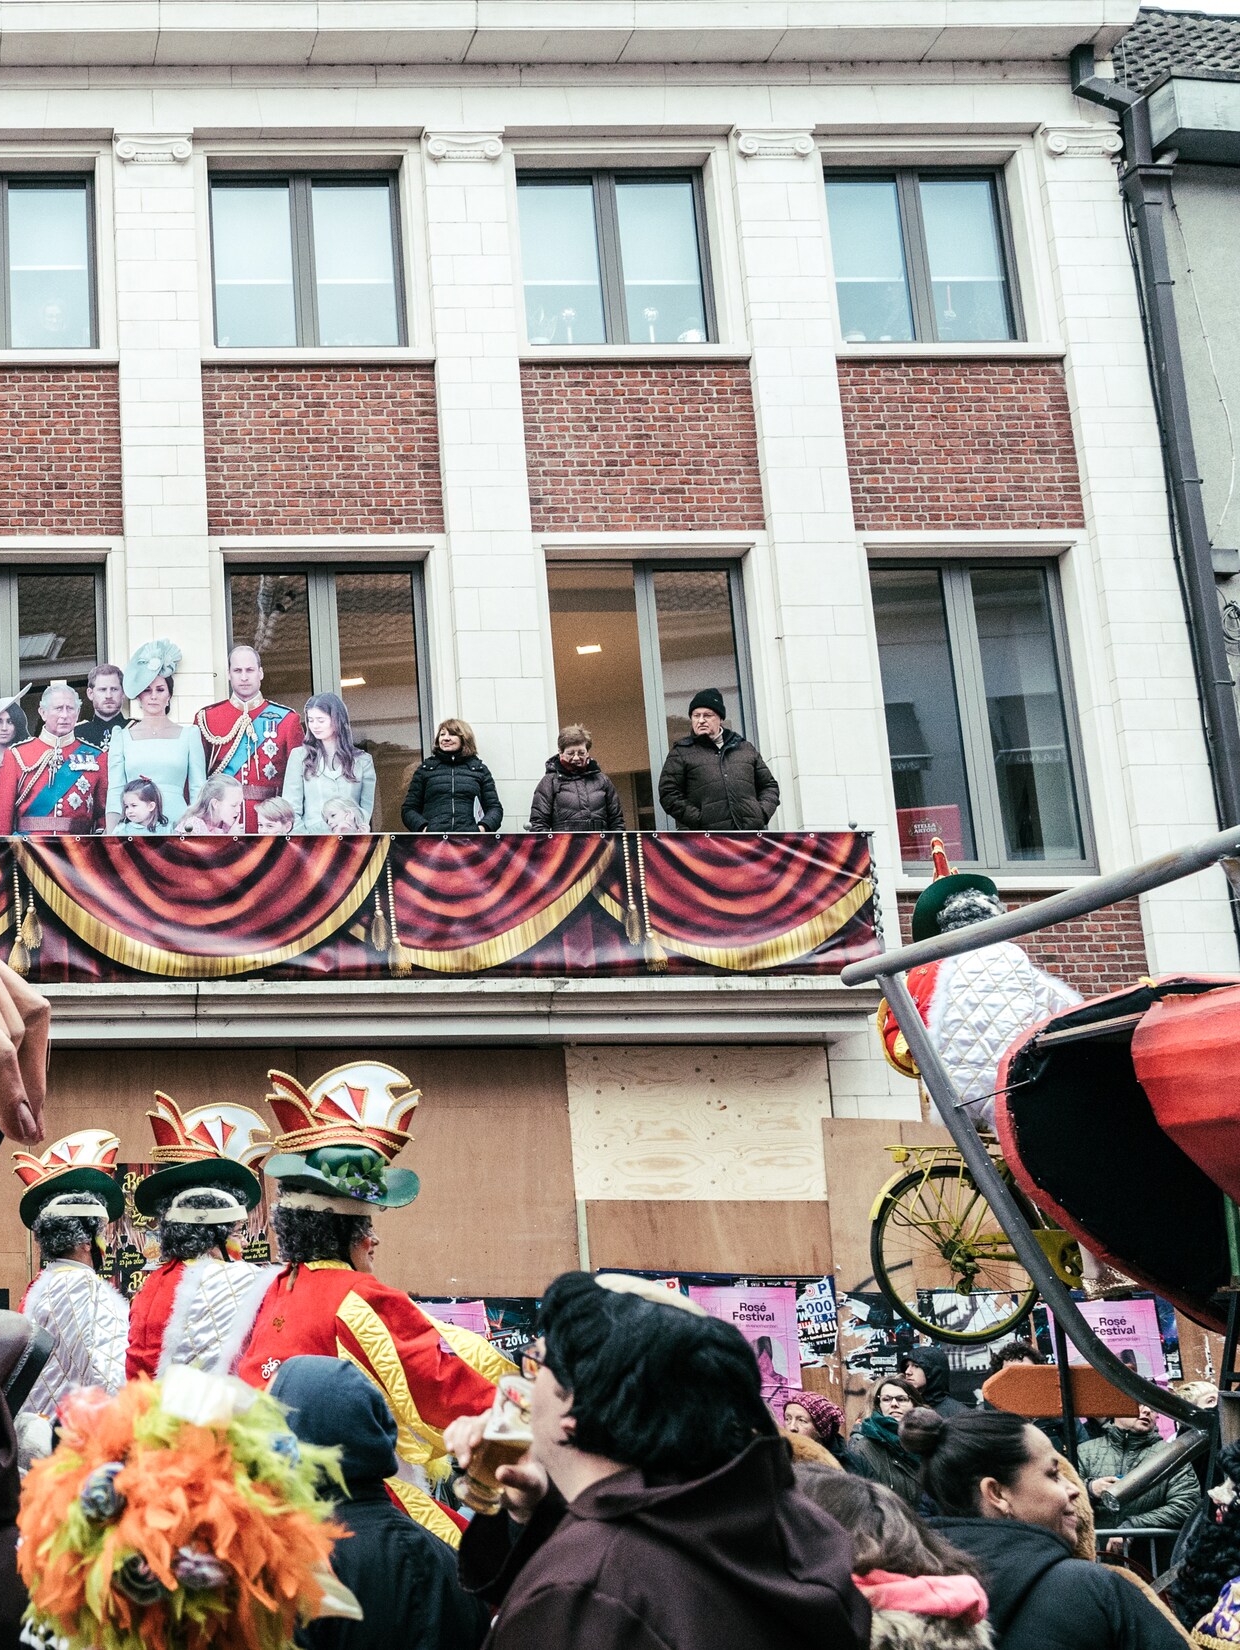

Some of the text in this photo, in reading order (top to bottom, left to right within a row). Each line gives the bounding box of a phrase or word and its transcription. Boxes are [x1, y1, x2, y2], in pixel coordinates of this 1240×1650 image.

[913, 822, 937, 830] STELLA
[740, 1302, 767, 1312] Rosé
[733, 1312, 775, 1321] Festival
[1099, 1316, 1127, 1326] Rosé
[807, 1320, 837, 1335] APRIL
[1093, 1325, 1136, 1335] Festival
[505, 1334, 529, 1347] 2016
